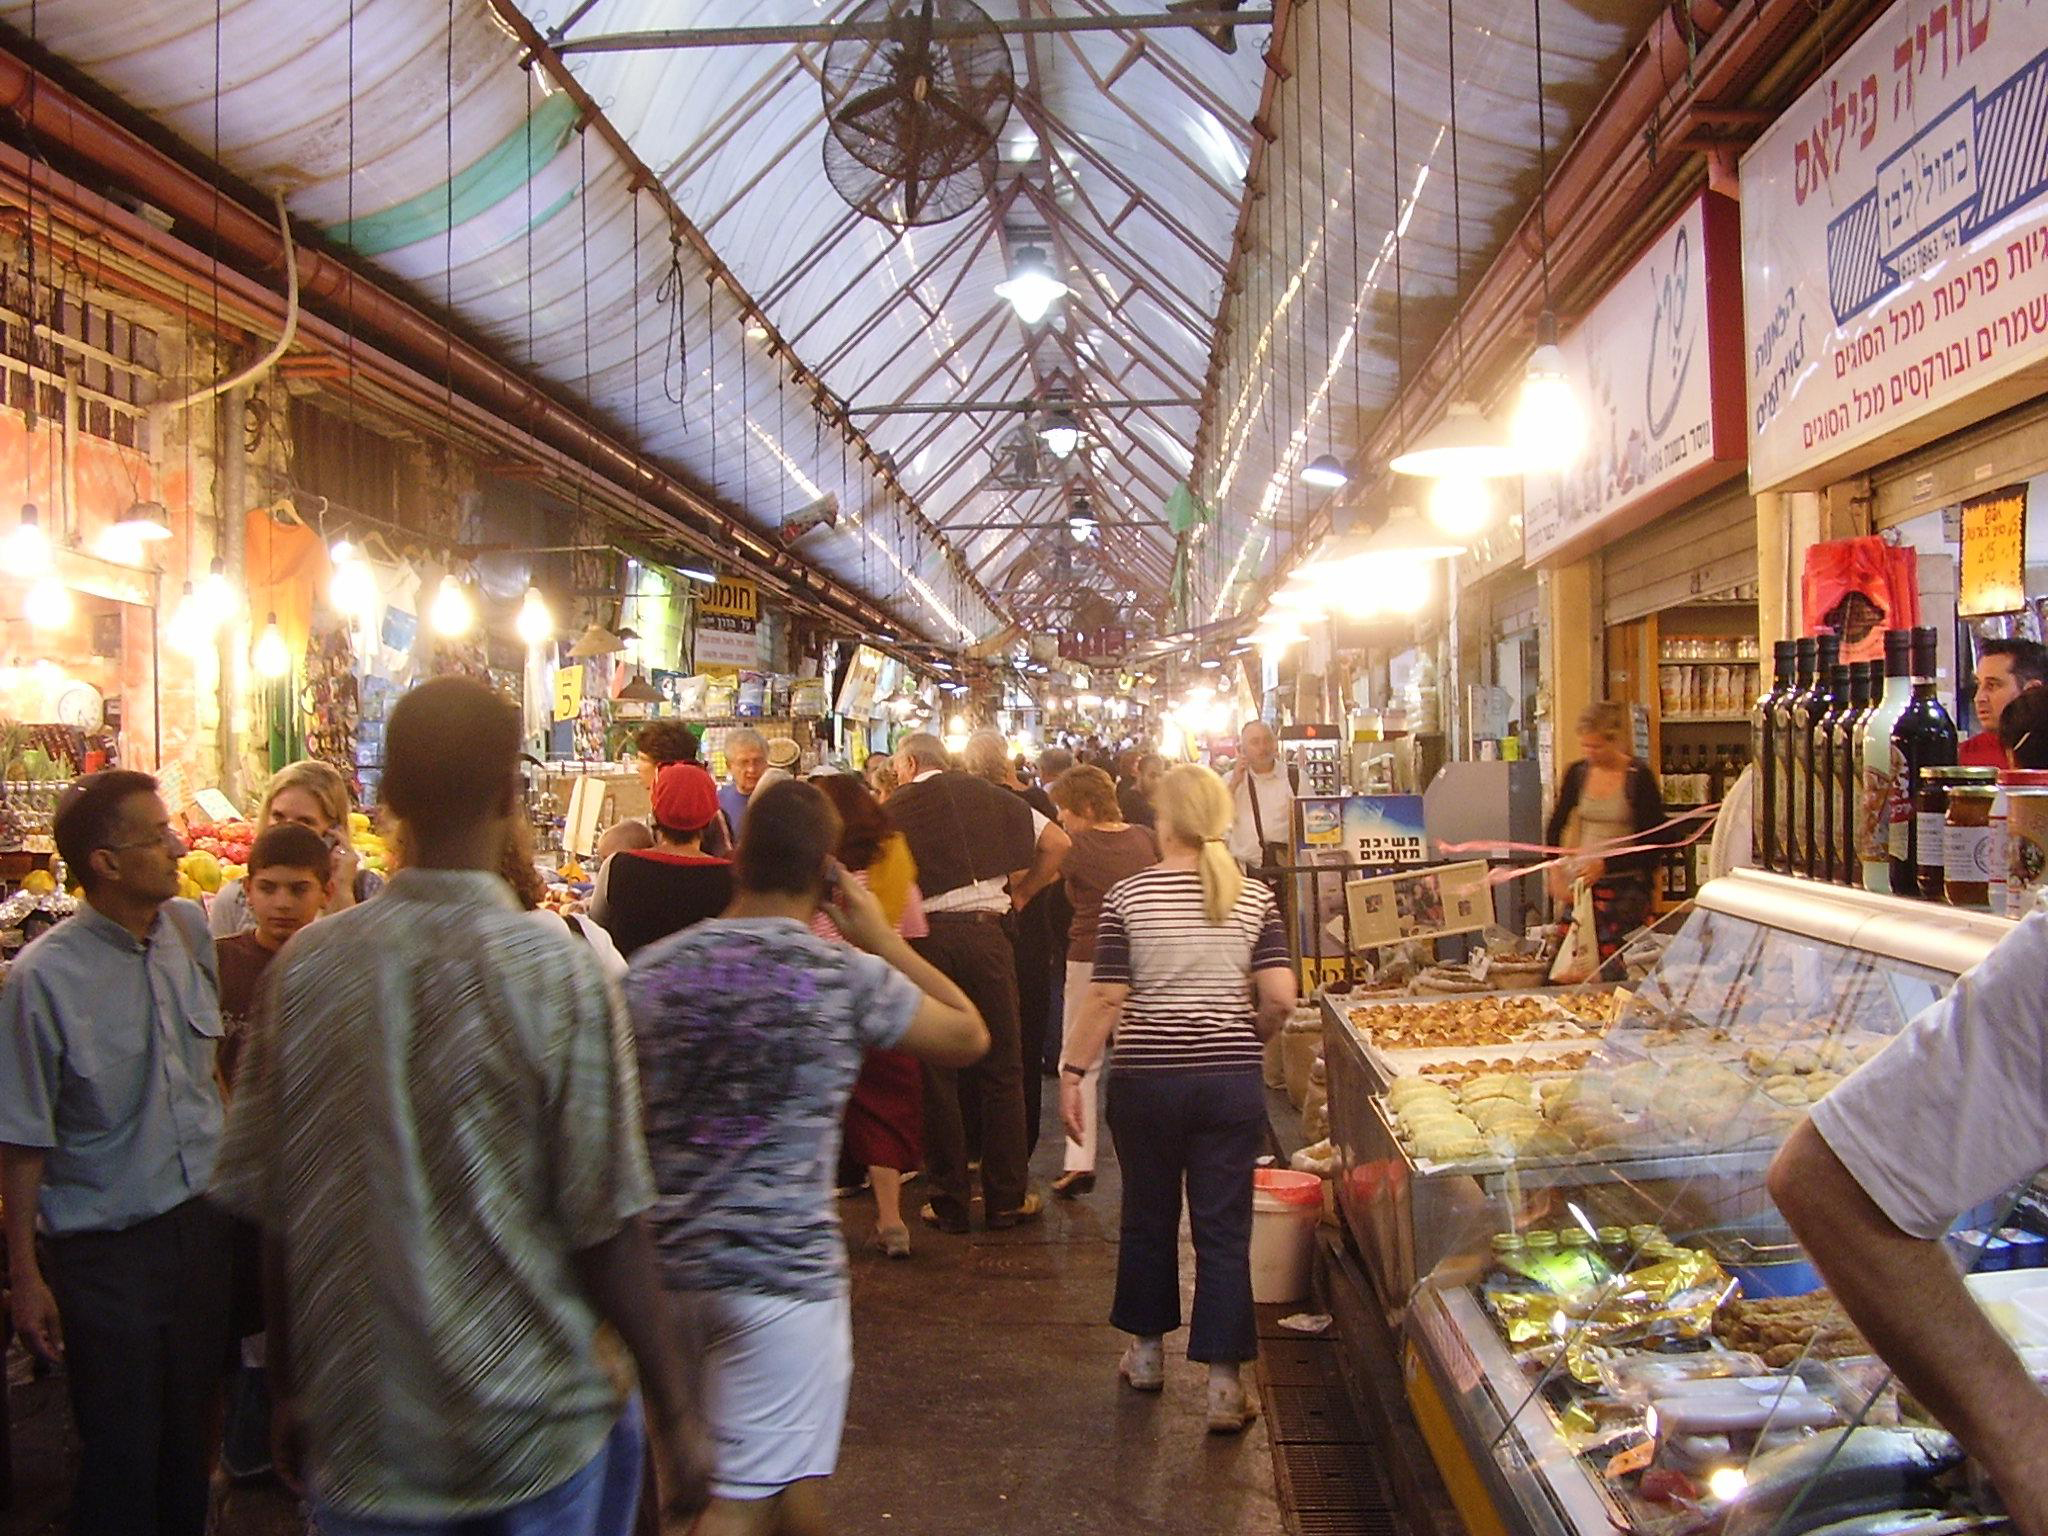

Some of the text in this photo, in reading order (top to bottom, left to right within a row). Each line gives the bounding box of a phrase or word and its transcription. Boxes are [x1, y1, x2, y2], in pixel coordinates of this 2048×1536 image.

[1794, 73, 1878, 207] פילאס
[1884, 138, 1968, 247] כחול לבן
[1932, 256, 2000, 322] פריכות
[1888, 299, 1926, 346] מכל
[1834, 324, 1886, 380] הסוגים
[1889, 336, 1972, 407] ובורקסים
[1801, 402, 1851, 450] הסוגים
[1852, 382, 1886, 424] מכל
[1359, 837, 1420, 849] משיכת
[1360, 849, 1421, 861] מזומנים
